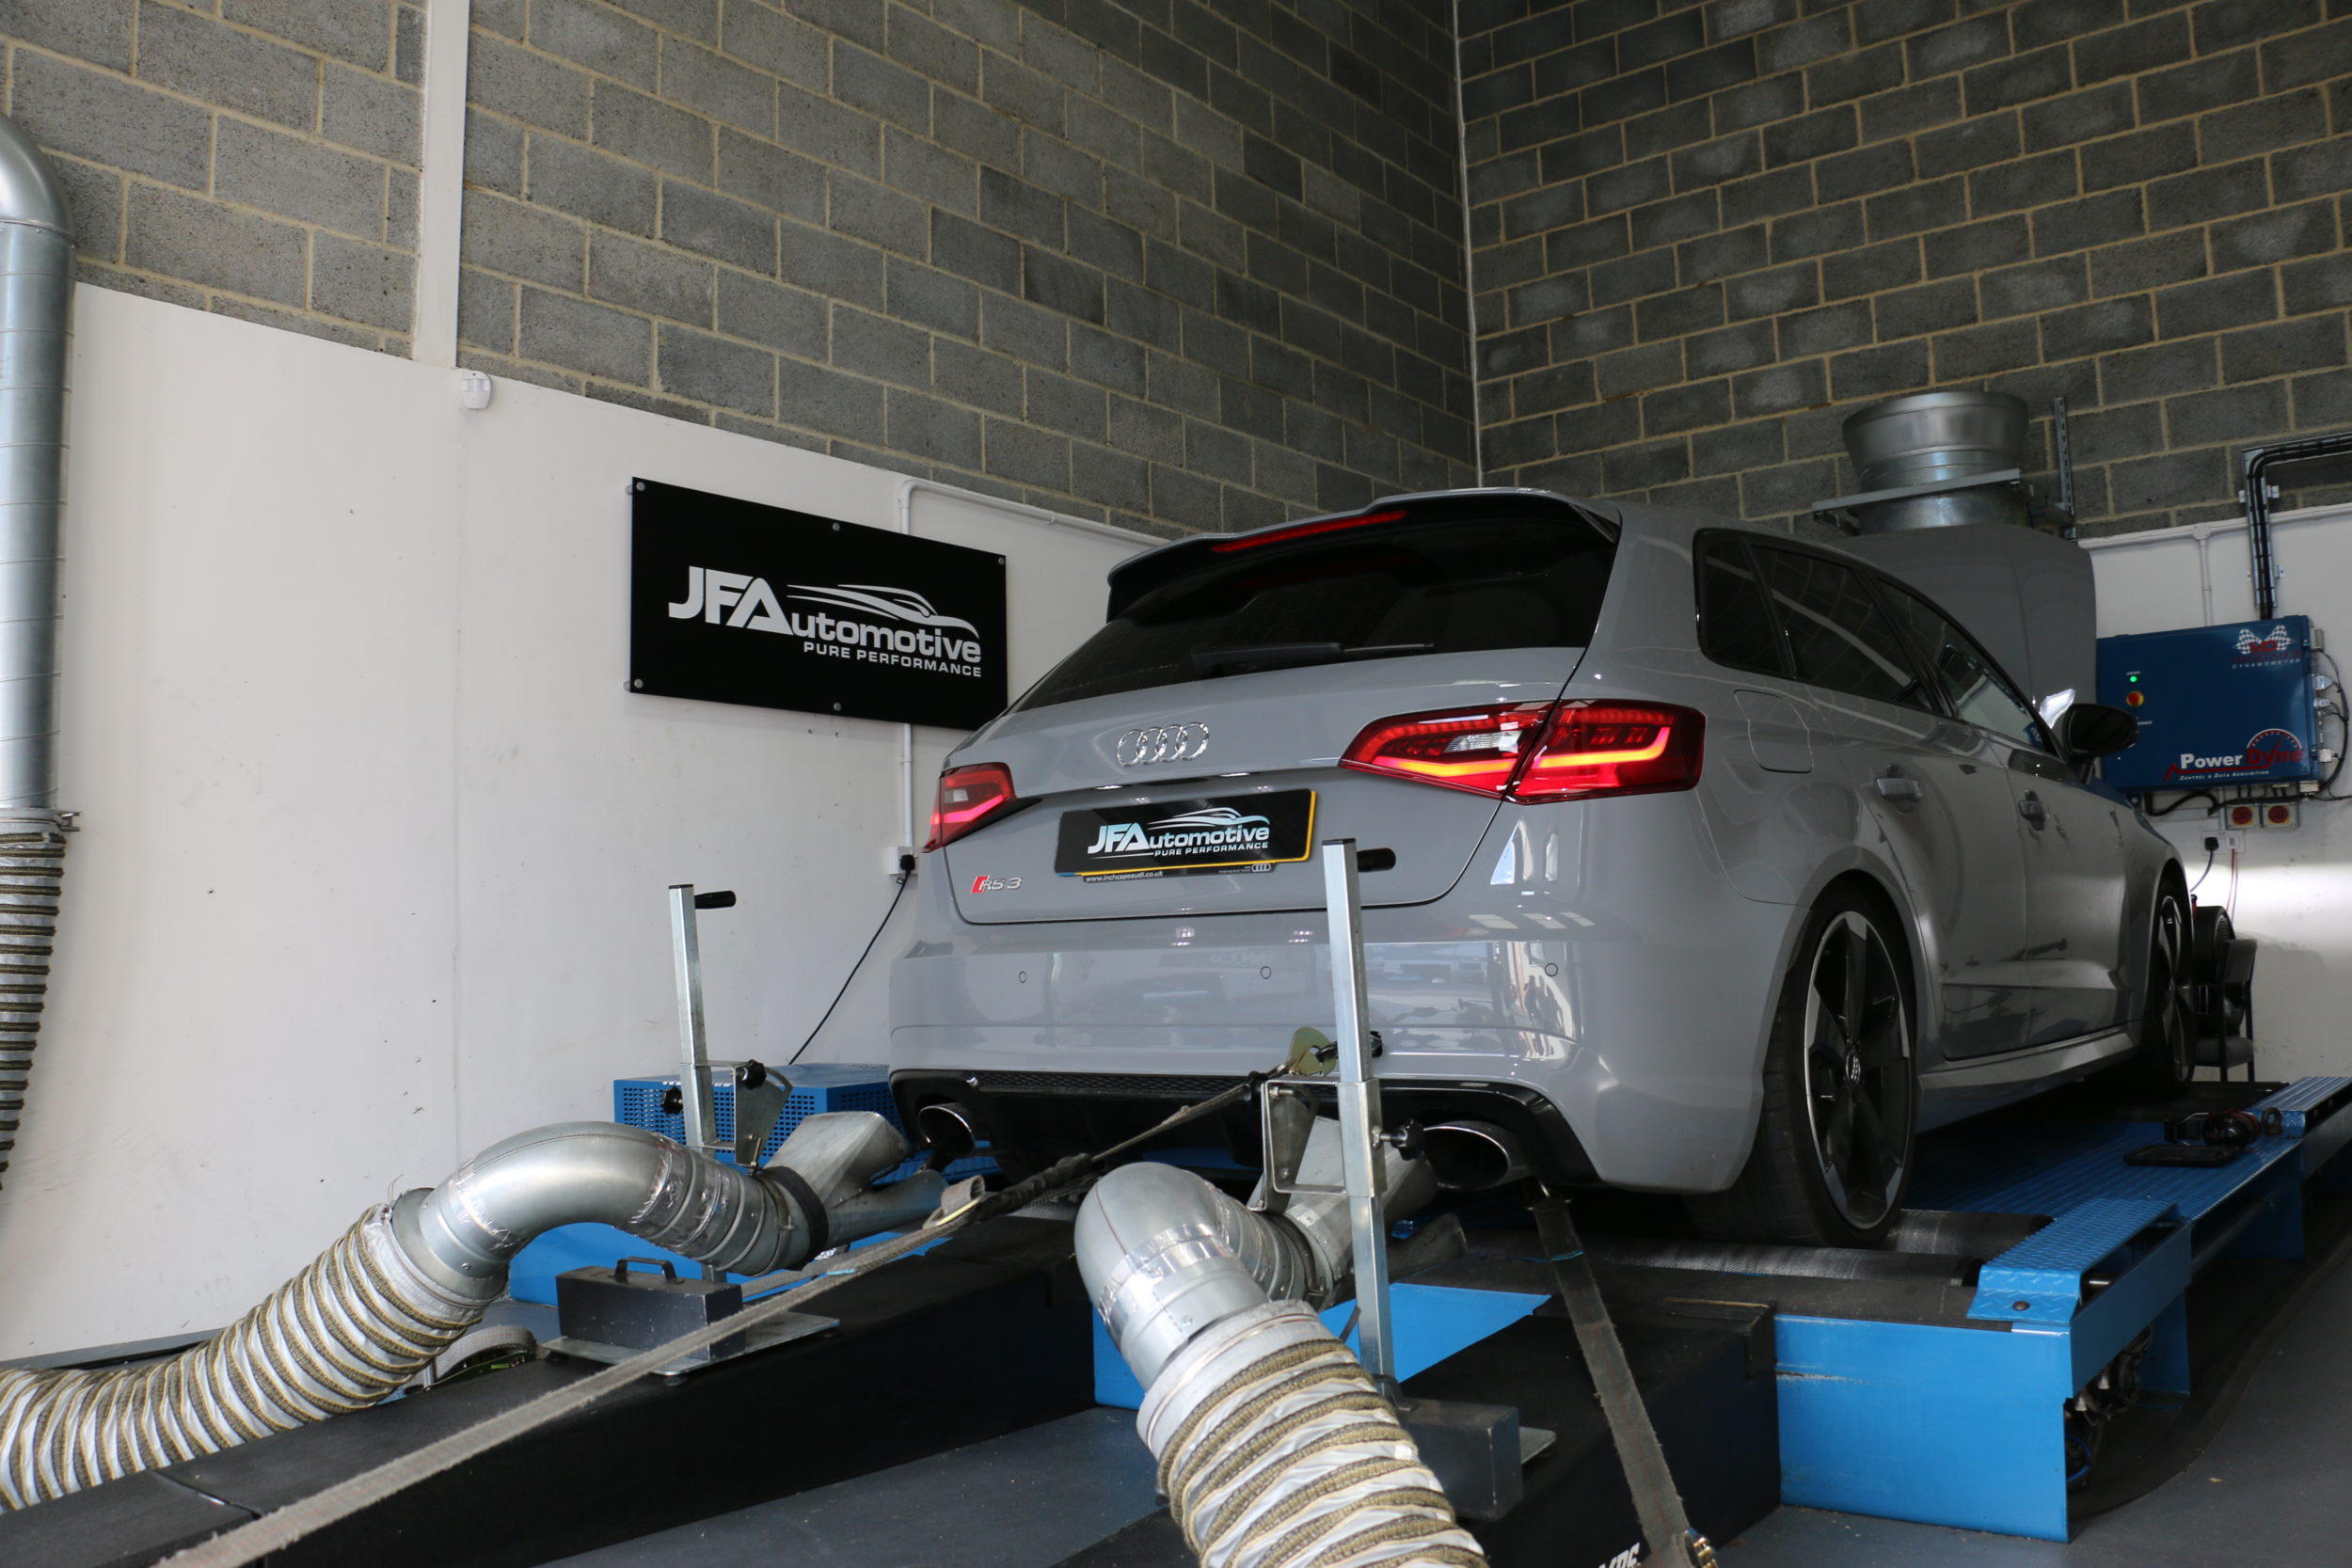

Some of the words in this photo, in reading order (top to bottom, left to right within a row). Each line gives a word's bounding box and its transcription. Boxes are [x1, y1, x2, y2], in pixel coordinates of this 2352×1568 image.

[669, 565, 981, 663] JFAutomotive
[803, 641, 850, 659] PURE
[857, 649, 981, 677] PERFORMANCE
[2180, 752, 2243, 769] Power
[1088, 822, 1269, 854] JFAutomotive
[1154, 848, 1182, 857] PURE
[1185, 842, 1268, 855] PERFORMANCE
[1086, 870, 1164, 883] www.inchcapeaudi.co.uk
